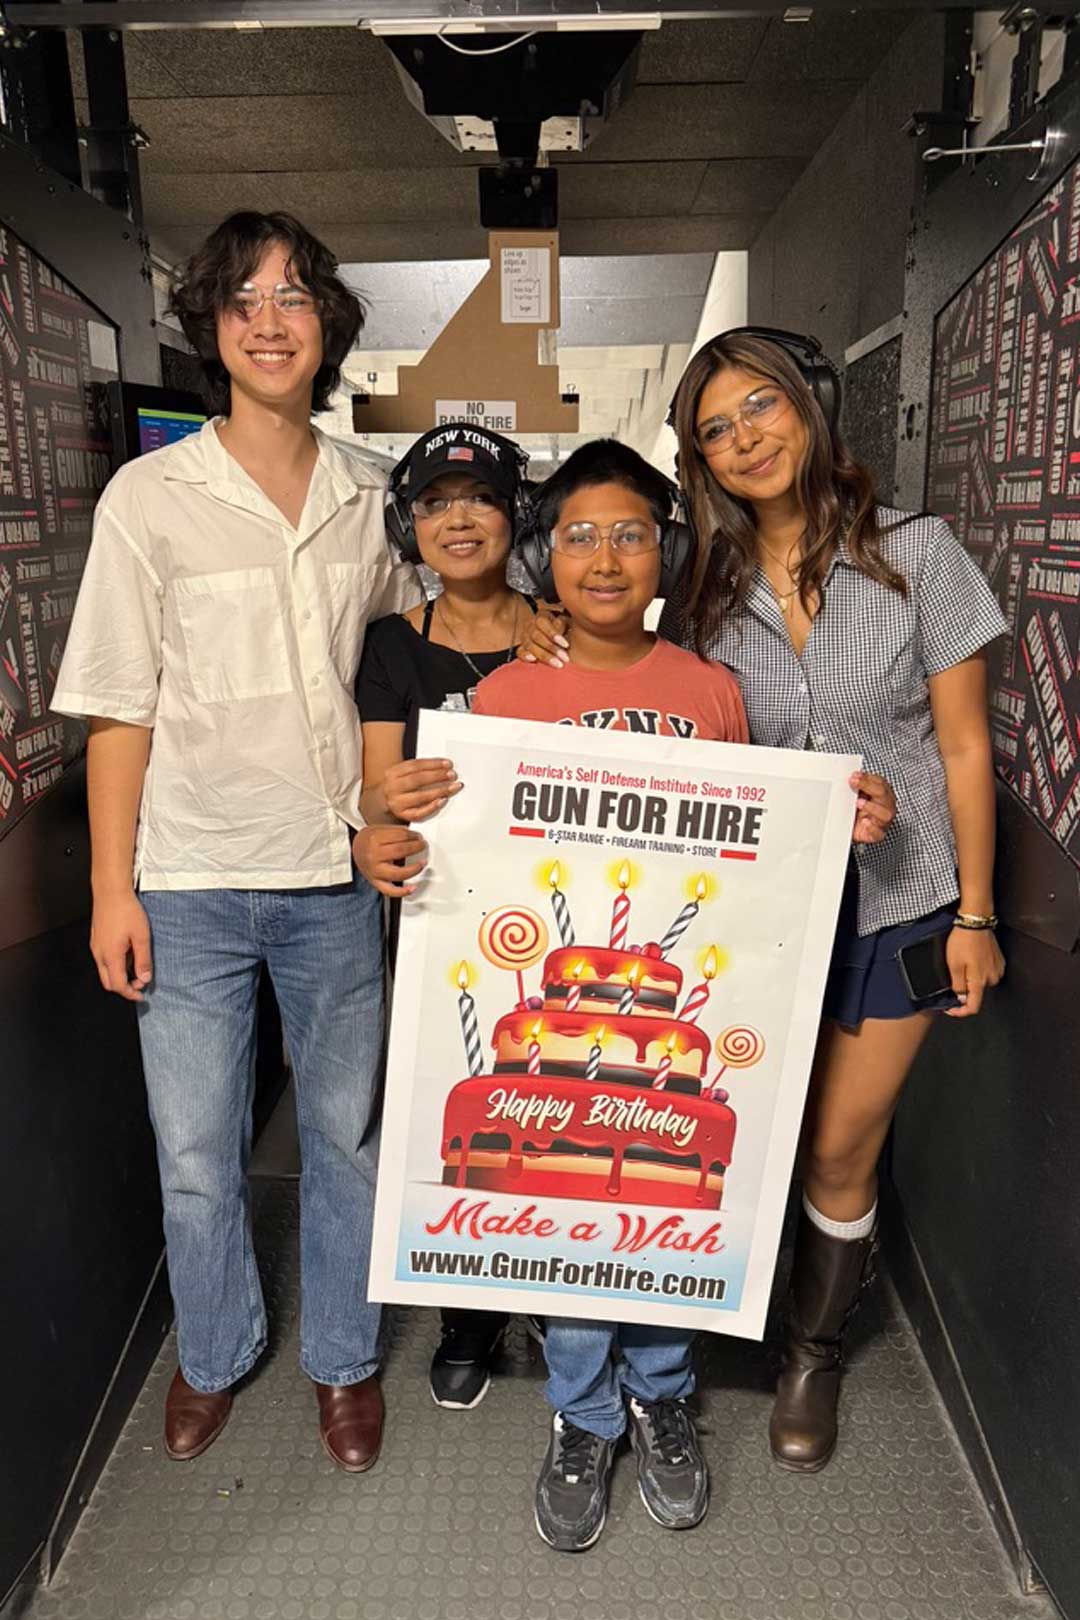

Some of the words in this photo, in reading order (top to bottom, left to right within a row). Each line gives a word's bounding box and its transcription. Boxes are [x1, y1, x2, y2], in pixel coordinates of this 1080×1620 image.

[1003, 243, 1020, 324] HRE
[998, 328, 1015, 391] FOR
[1039, 330, 1053, 375] HRE
[1058, 347, 1073, 400] HRE
[10, 379, 25, 422] HRE
[466, 402, 485, 415] NO
[483, 416, 512, 429] FIRE
[1054, 402, 1068, 445] FOR
[33, 405, 50, 451] HRE
[425, 430, 460, 458] NEW
[462, 430, 501, 461] YORK
[994, 397, 1009, 464] GUN
[1016, 407, 1029, 456] HRE
[1051, 450, 1063, 495] GUN
[18, 592, 33, 636] HRE
[1026, 615, 1047, 673] GUN
[1037, 663, 1059, 720] FOR
[1050, 710, 1075, 781] HRE
[517, 761, 573, 781] America's
[575, 767, 599, 783] Self
[601, 770, 646, 789] Defense
[650, 776, 698, 795] Institute
[701, 782, 732, 799] Since
[736, 786, 766, 802] 1992
[511, 780, 590, 826] GUN
[597, 790, 668, 834] FOR
[676, 799, 765, 845] HIRE
[578, 833, 605, 845] RANGE
[611, 837, 647, 850] FIREARM
[648, 840, 685, 855] TRAINING
[691, 845, 717, 858] STORE
[486, 1088, 575, 1132] Happy
[582, 1094, 699, 1147] Birthday
[425, 1198, 559, 1240] Make
[570, 1220, 601, 1242] a
[612, 1213, 726, 1255] Wish
[409, 1249, 727, 1300] www.GunForHire.com
